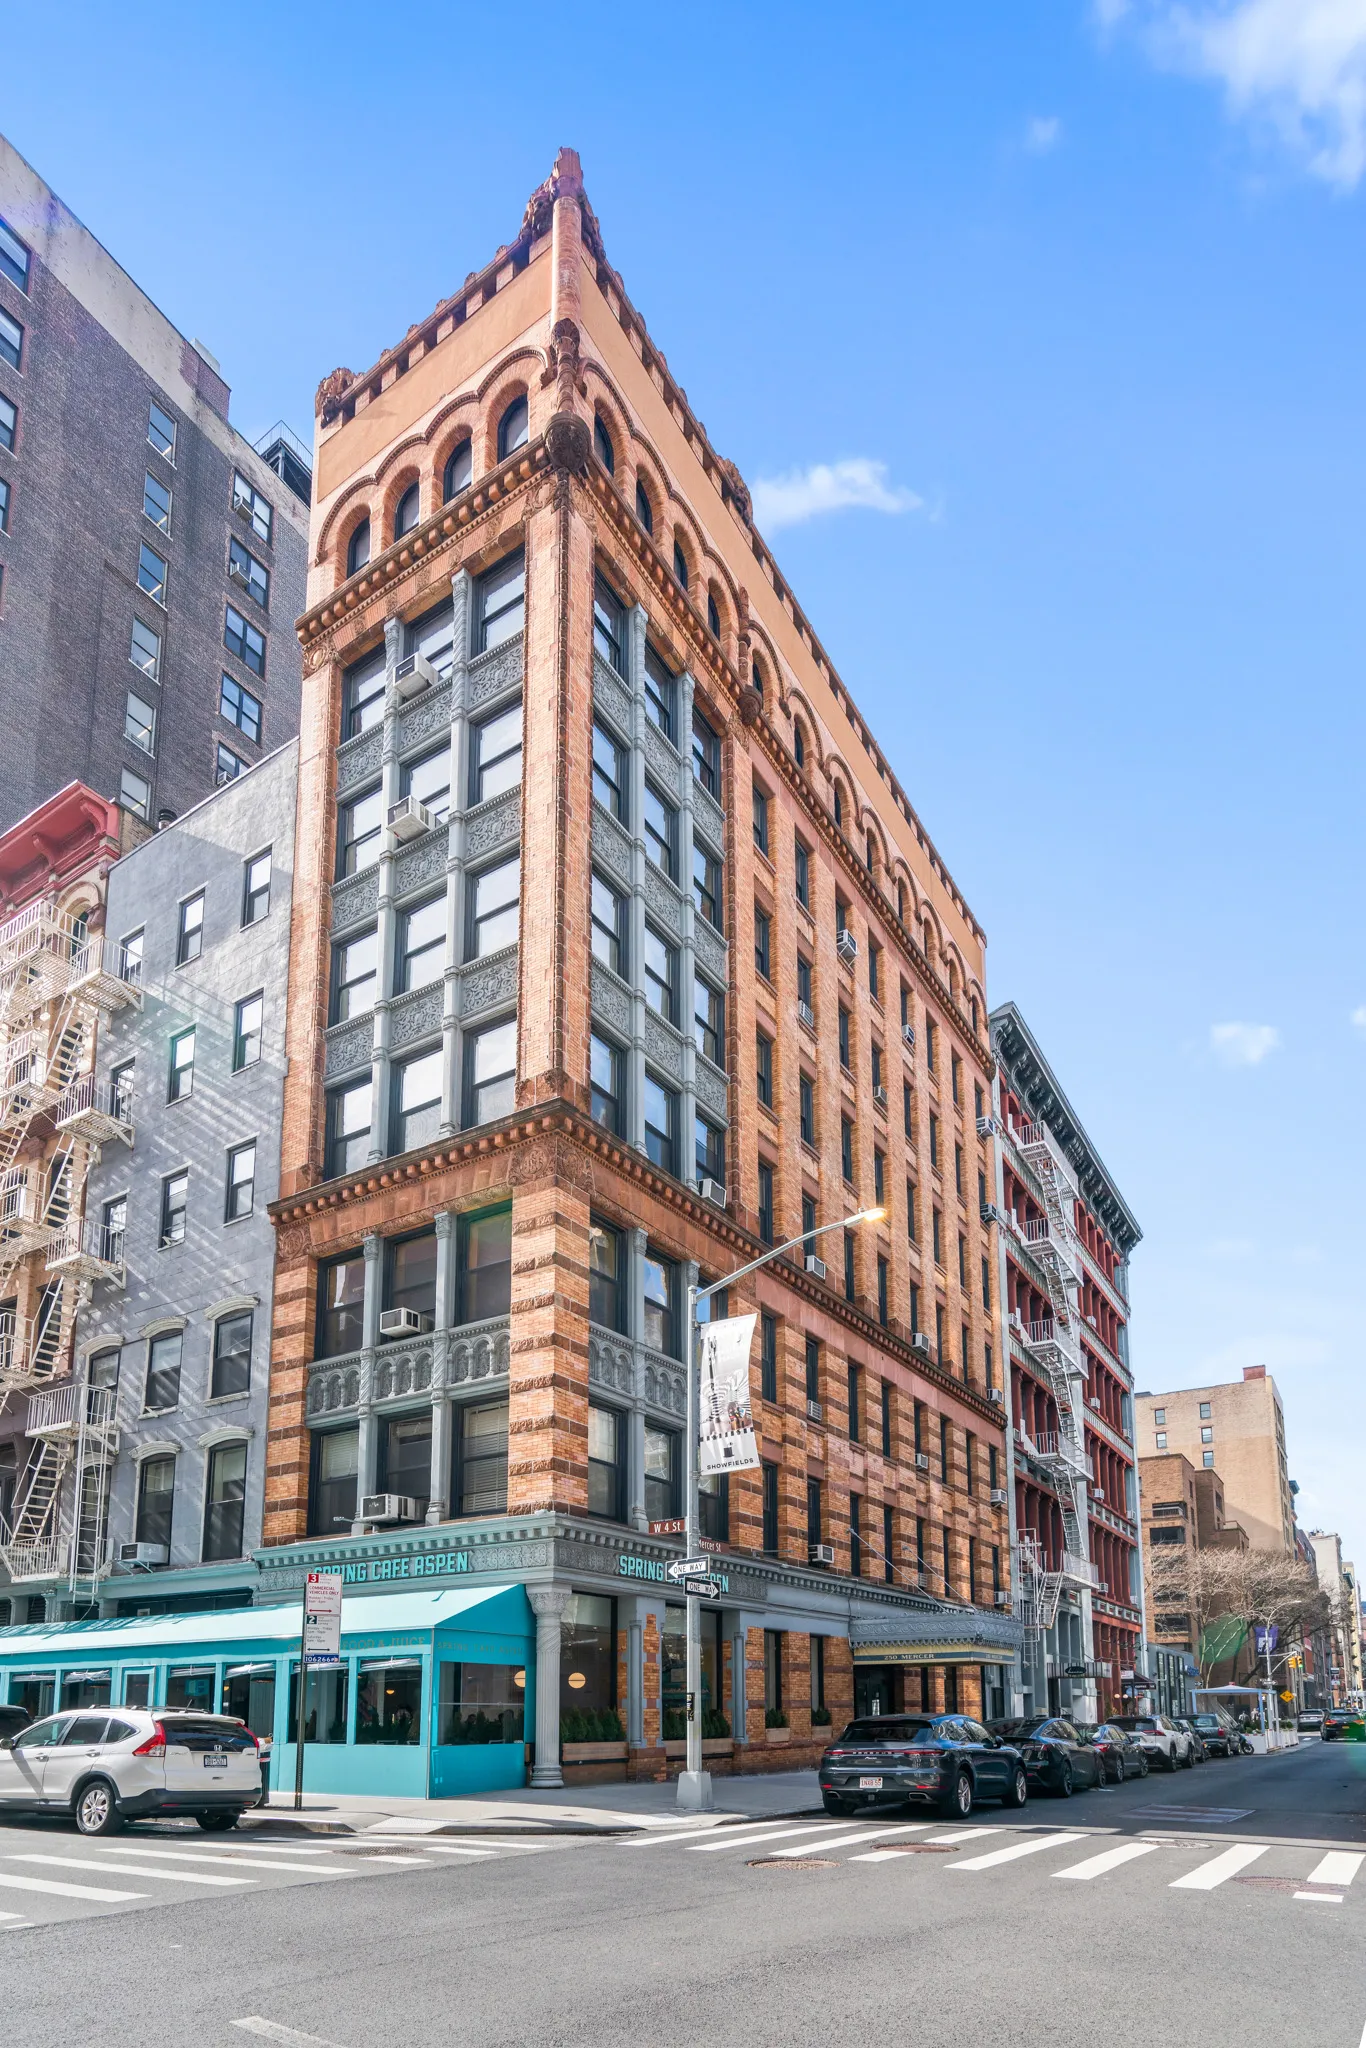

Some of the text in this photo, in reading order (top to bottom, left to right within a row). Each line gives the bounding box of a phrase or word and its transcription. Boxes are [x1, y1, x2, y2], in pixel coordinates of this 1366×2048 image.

[707, 1458, 754, 1470] SHOWFIELDS
[653, 1521, 681, 1533] W 4 St
[715, 1542, 722, 1553] St
[372, 1557, 409, 1579] CAFE
[415, 1551, 468, 1575] ASPEN
[619, 1555, 664, 1581] SPRING
[674, 1563, 703, 1574] ONE WAY
[310, 1574, 317, 1583] 3
[690, 1582, 700, 1591] ONE
[704, 1585, 716, 1594] WAY
[308, 1616, 315, 1624] 2
[388, 1636, 425, 1648] JUICE
